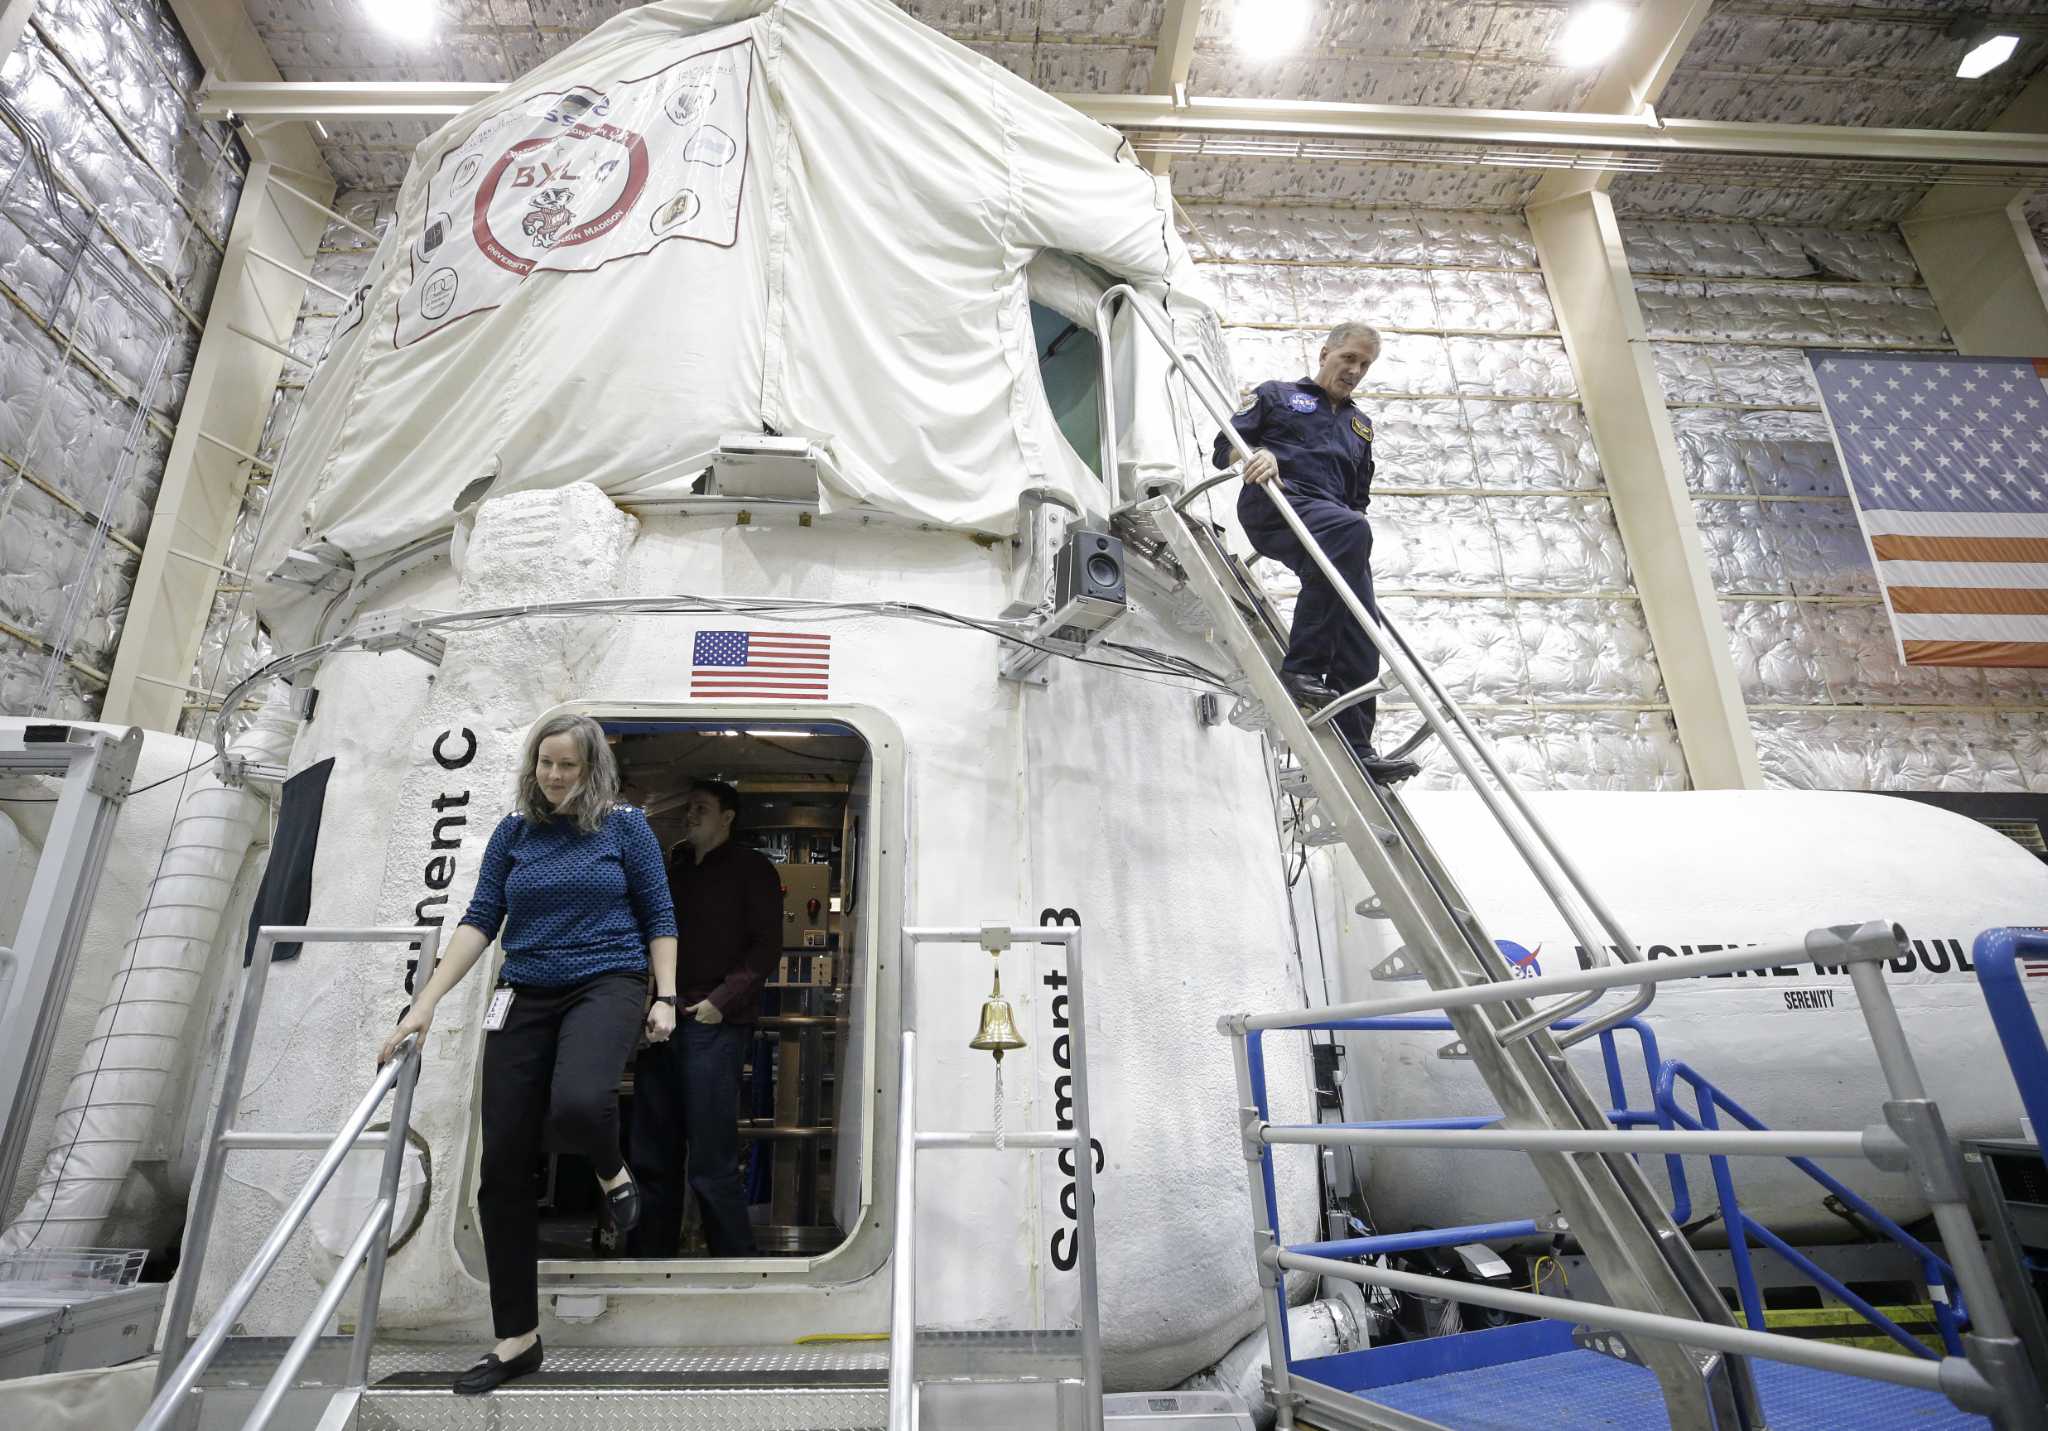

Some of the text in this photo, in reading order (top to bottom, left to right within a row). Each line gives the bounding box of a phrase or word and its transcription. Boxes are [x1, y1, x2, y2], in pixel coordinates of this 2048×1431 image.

[487, 243, 529, 271] UNIVERSITY
[584, 210, 624, 238] MADISON
[432, 727, 477, 770] C
[1784, 989, 1834, 1010] SERENITY
